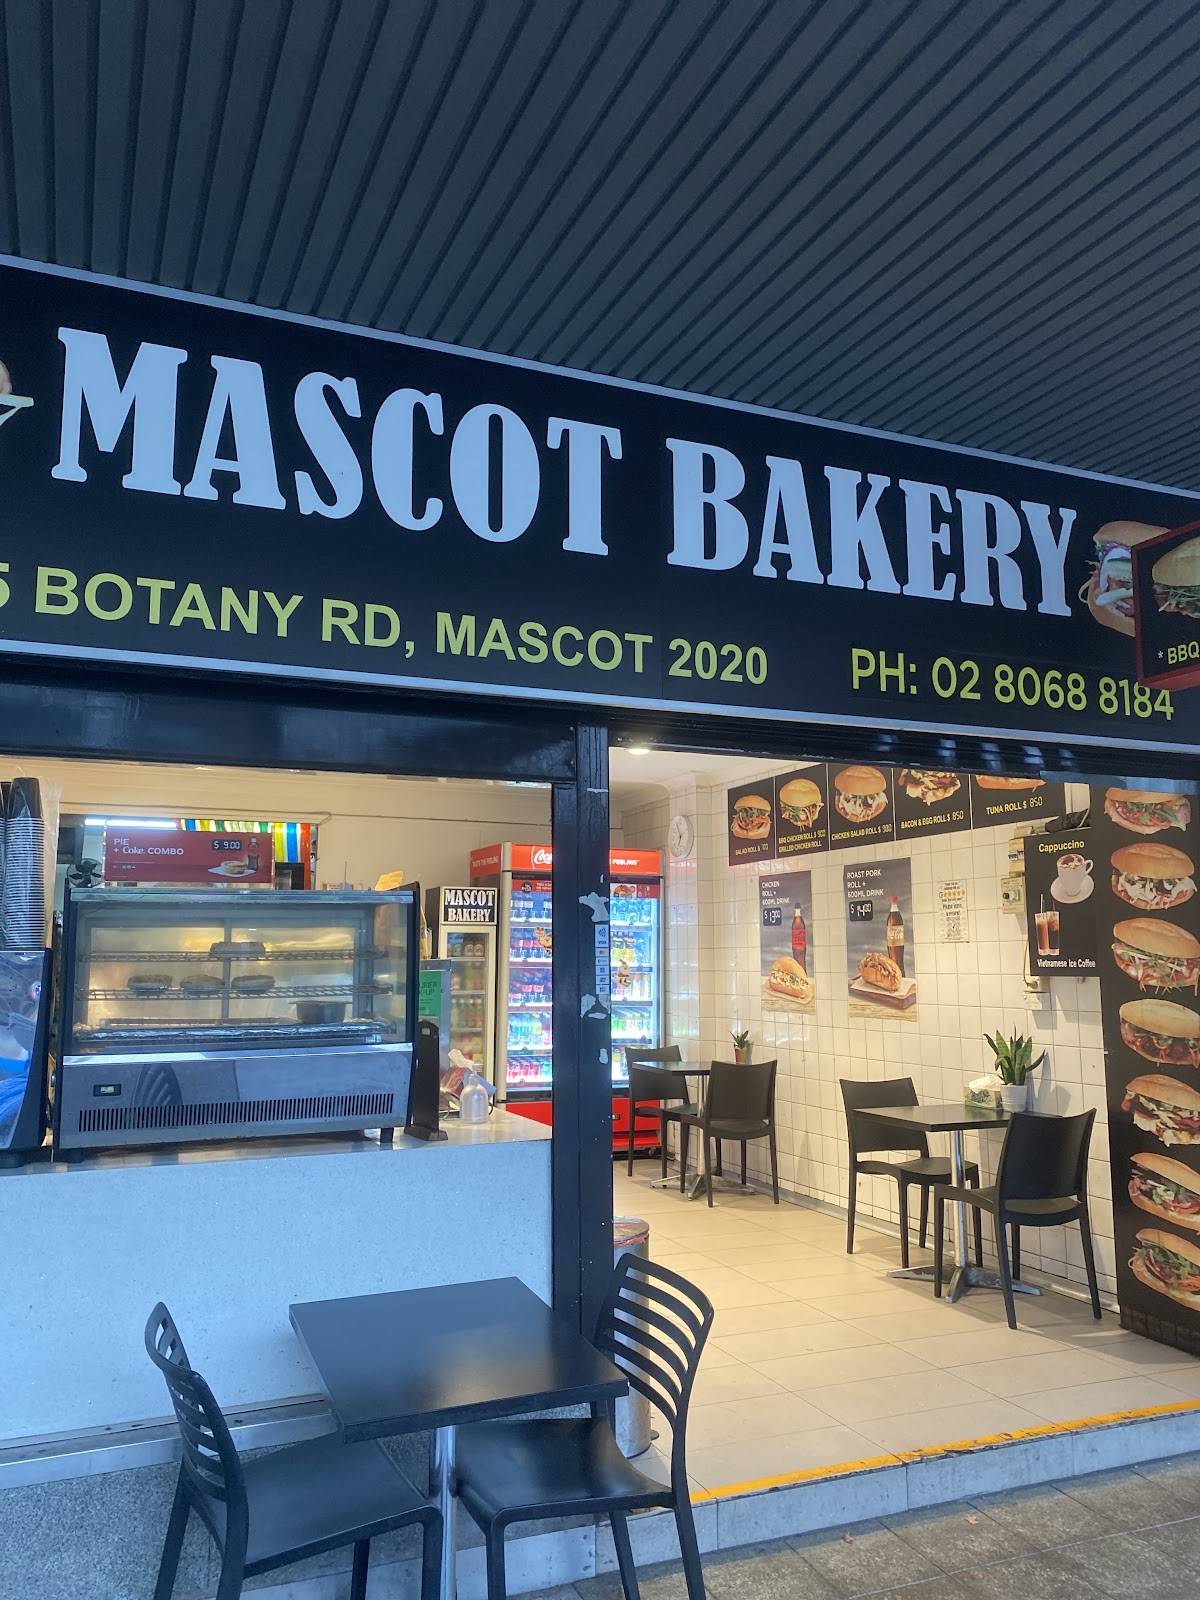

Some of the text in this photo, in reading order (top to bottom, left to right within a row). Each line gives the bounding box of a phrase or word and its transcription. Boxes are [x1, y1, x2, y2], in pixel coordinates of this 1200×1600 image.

[51, 326, 1077, 618] MASCOT BAKERY
[35, 566, 303, 638] BOTANY
[321, 599, 415, 659] RD,
[436, 611, 653, 673] MASCOT
[668, 638, 768, 685] 2020
[852, 648, 1174, 721] PH: 02 8068 8184
[986, 805, 1004, 815] TUNA
[1004, 802, 1022, 812] ROLL
[901, 820, 917, 829] BACON
[922, 817, 933, 825] EGG
[934, 815, 946, 823] ROLL
[148, 847, 184, 856] COMBO
[214, 841, 220, 850] $
[1039, 840, 1084, 853] Cappuccino
[445, 890, 494, 906] MASCOT
[448, 908, 491, 922] BAKERY
[1037, 959, 1096, 967] Vietnamese Ice Coffee
